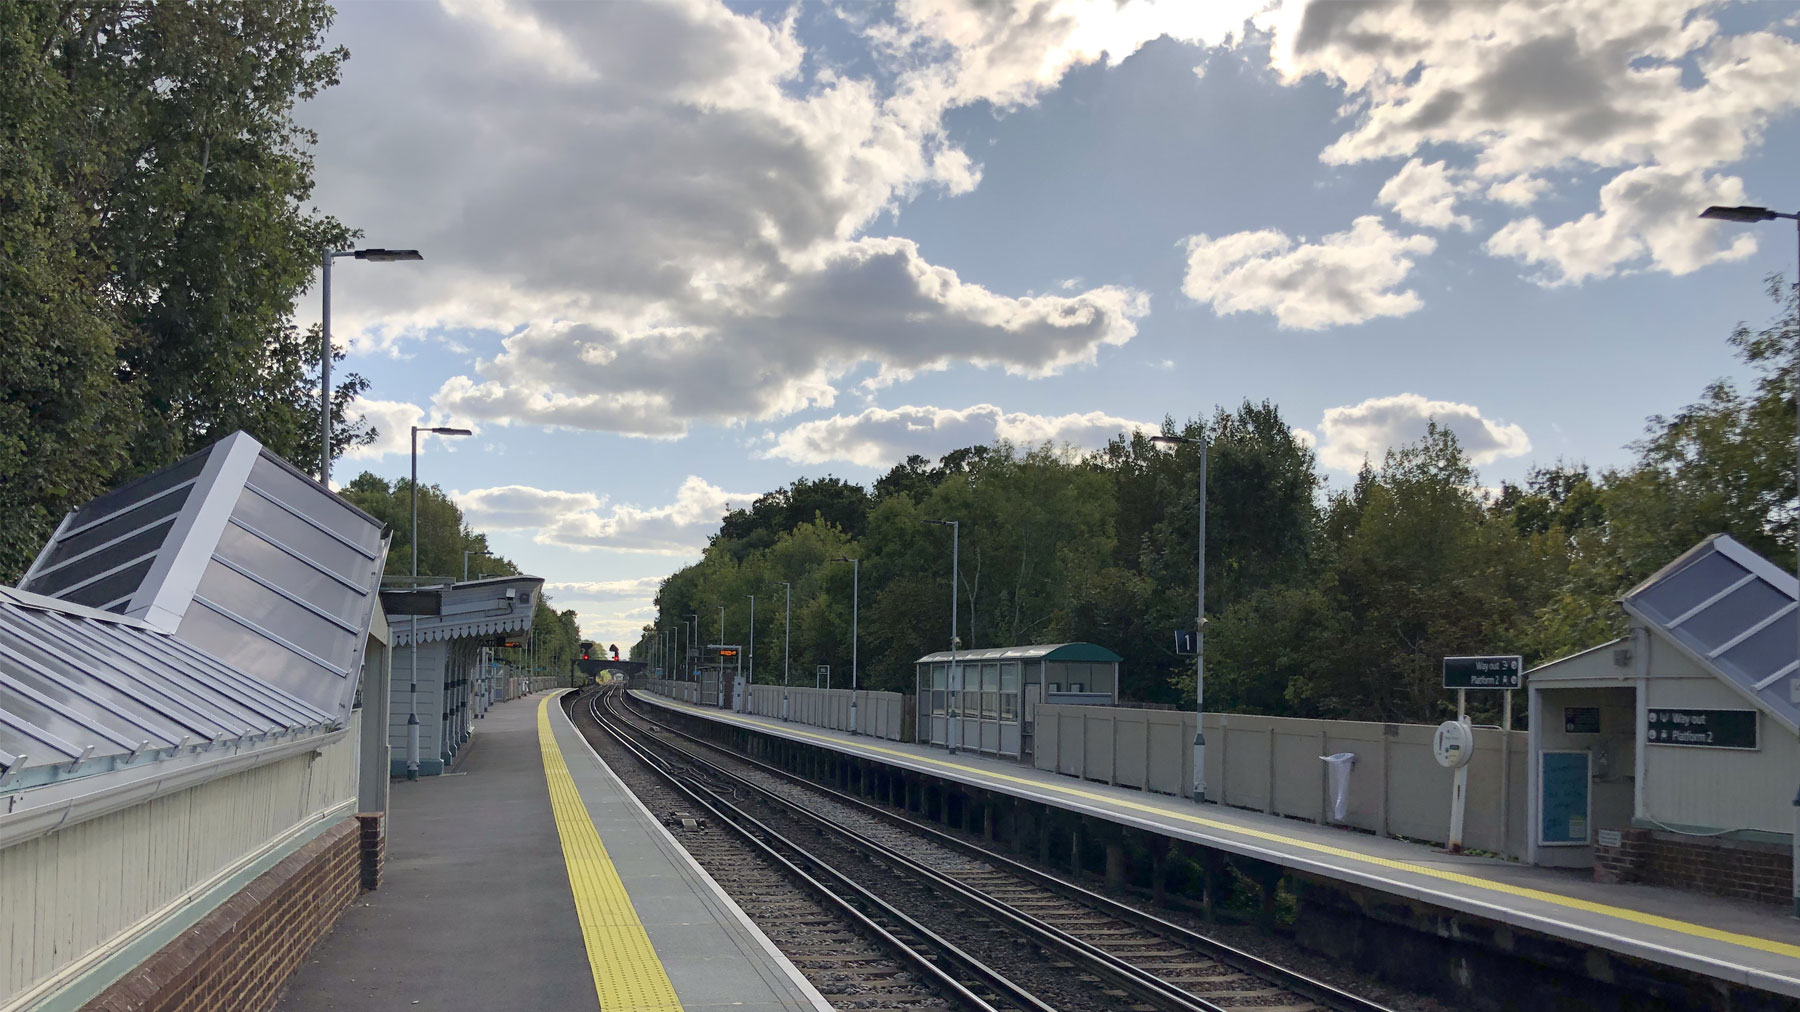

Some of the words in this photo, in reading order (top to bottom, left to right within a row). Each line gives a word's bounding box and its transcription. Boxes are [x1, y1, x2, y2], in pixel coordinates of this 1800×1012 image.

[1184, 634, 1190, 651] 1
[1475, 660, 1489, 672] Way
[1489, 661, 1500, 670] out
[1471, 675, 1495, 685] Platform
[1495, 675, 1500, 685] 2
[1672, 713, 1690, 726] Way
[1691, 715, 1706, 724] out
[1672, 730, 1706, 742] Platform
[1706, 731, 1713, 743] 2
